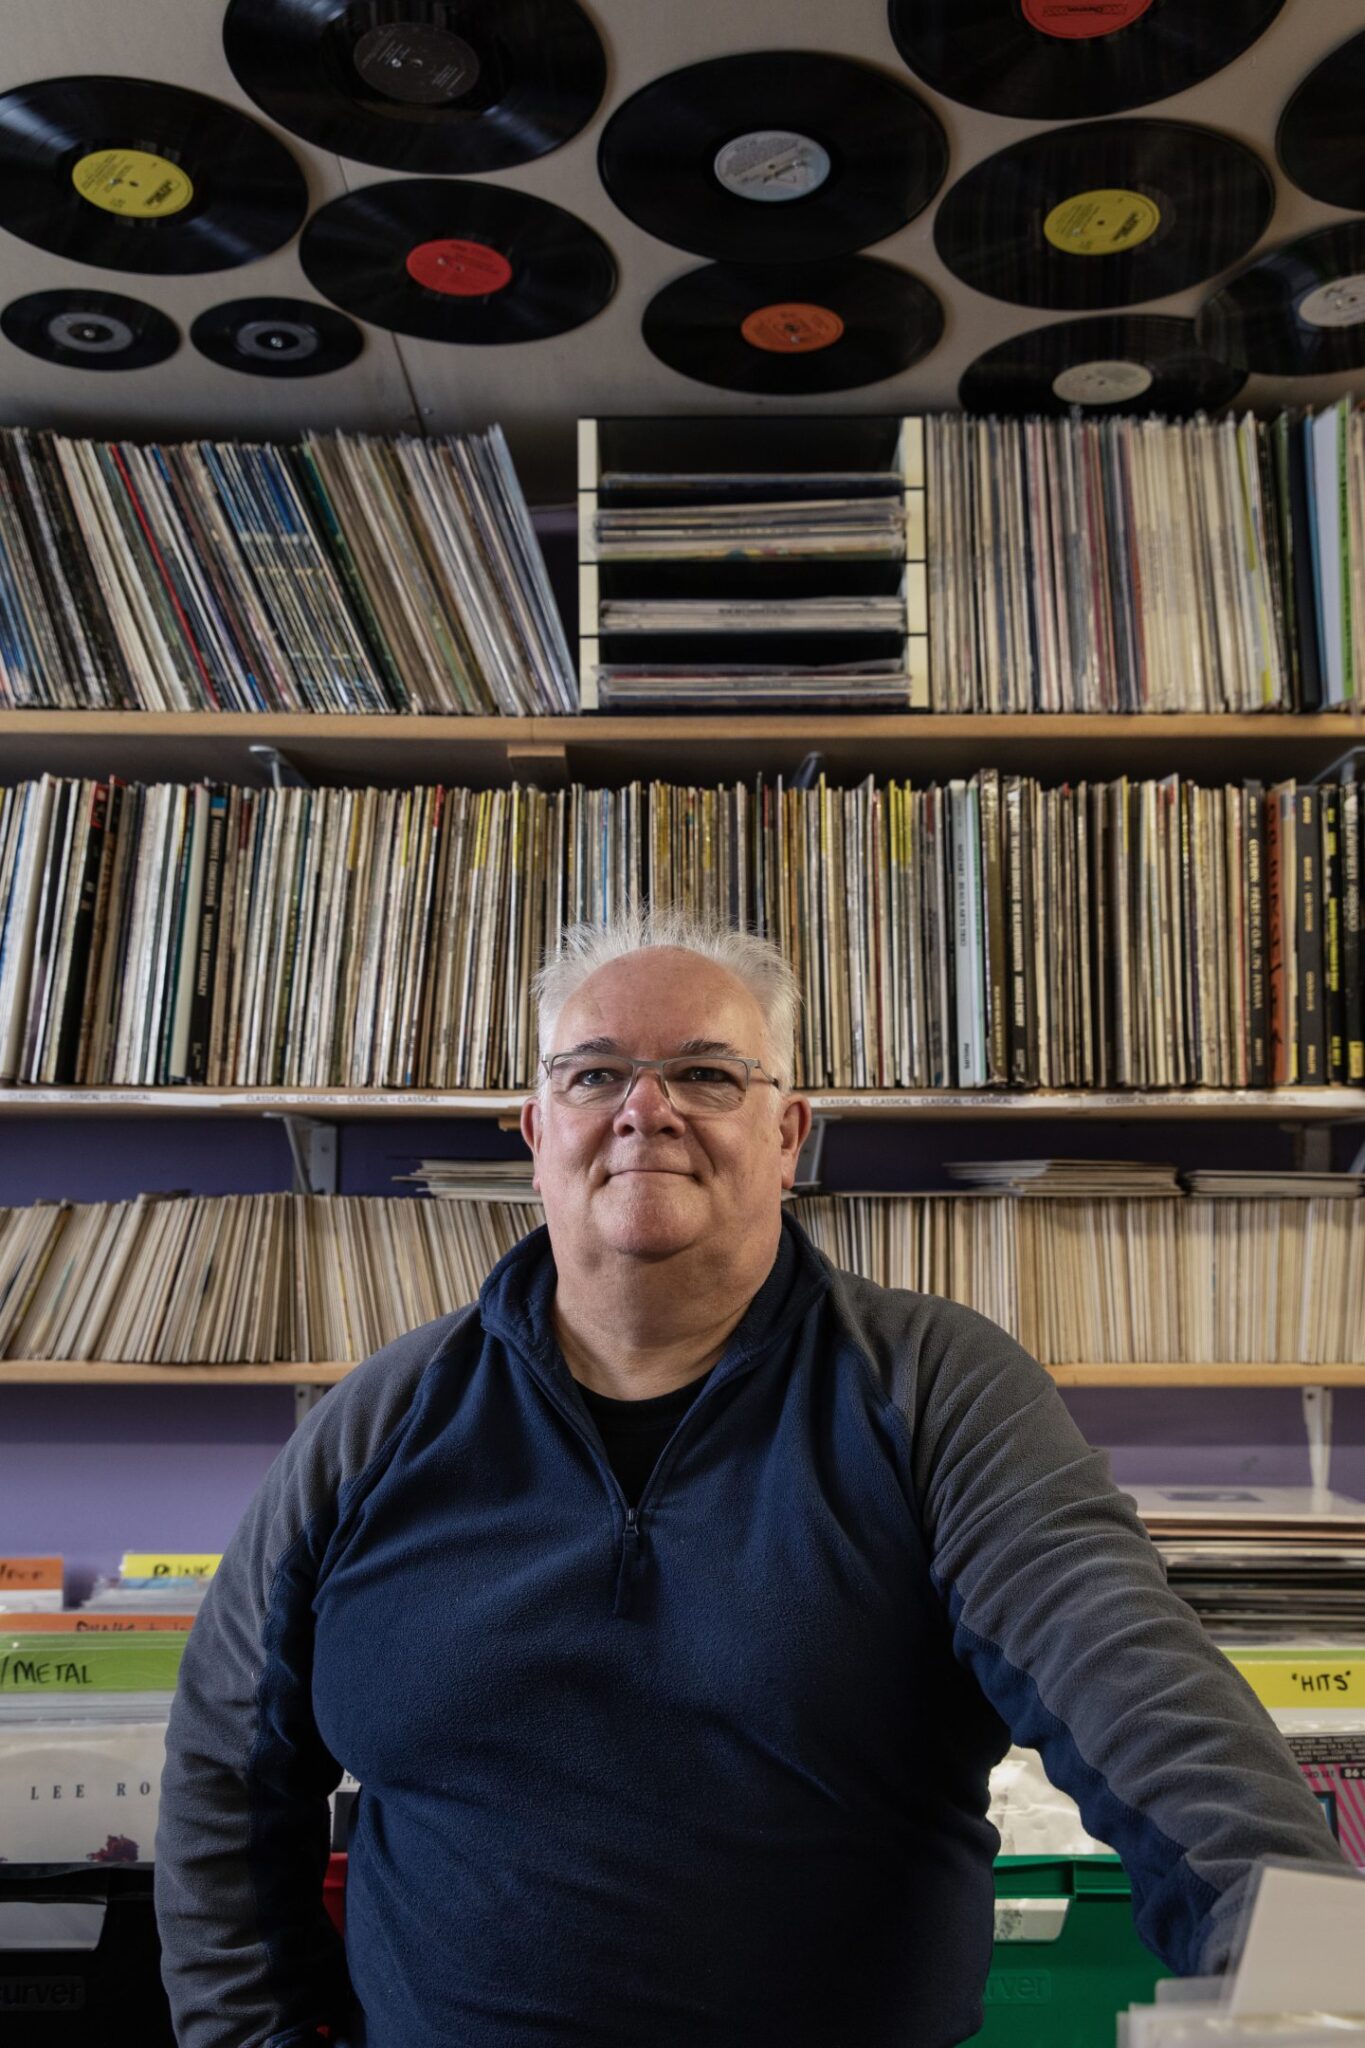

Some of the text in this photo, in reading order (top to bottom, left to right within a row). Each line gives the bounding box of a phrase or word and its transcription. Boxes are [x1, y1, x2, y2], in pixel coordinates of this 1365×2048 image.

[205, 860, 218, 907] CONCERTOS
[202, 913, 214, 952] VLADIMIR
[1344, 1768, 1360, 1778] 86
[30, 1781, 151, 1800] LEE RO
